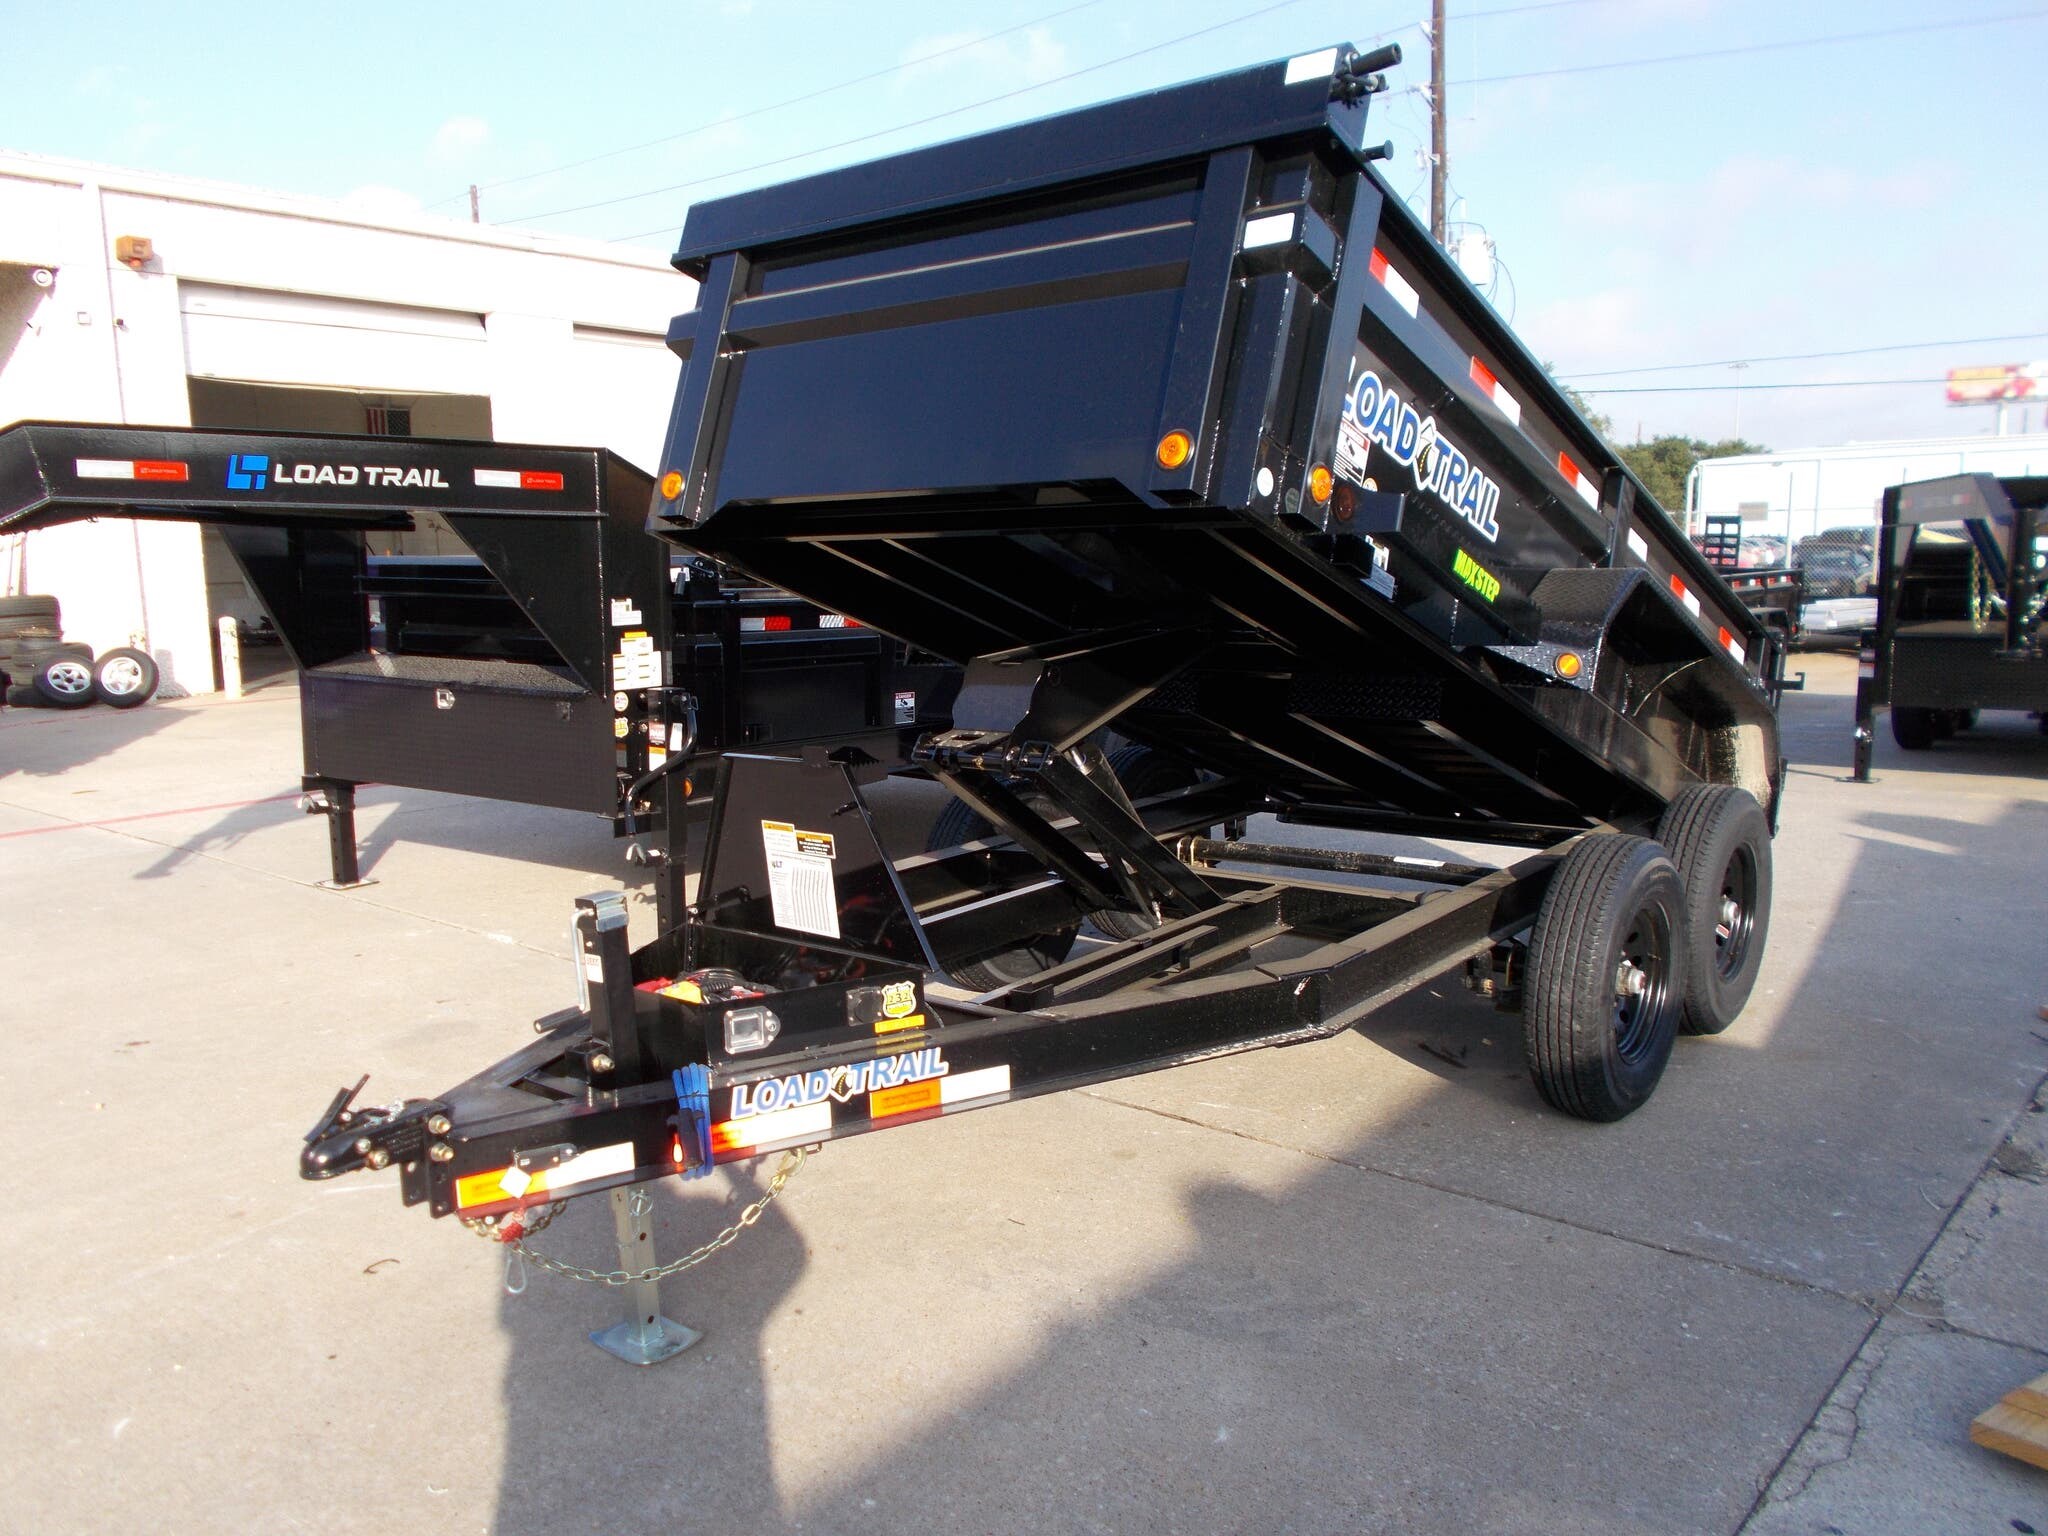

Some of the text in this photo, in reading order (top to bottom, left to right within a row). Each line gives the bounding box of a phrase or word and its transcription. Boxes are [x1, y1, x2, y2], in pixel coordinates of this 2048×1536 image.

[274, 463, 449, 488] LOAD TRAIL
[1432, 431, 1500, 544] TRAIL
[1453, 549, 1500, 602] MAXSTEP
[731, 1046, 950, 1120] LOAD TRAIL
